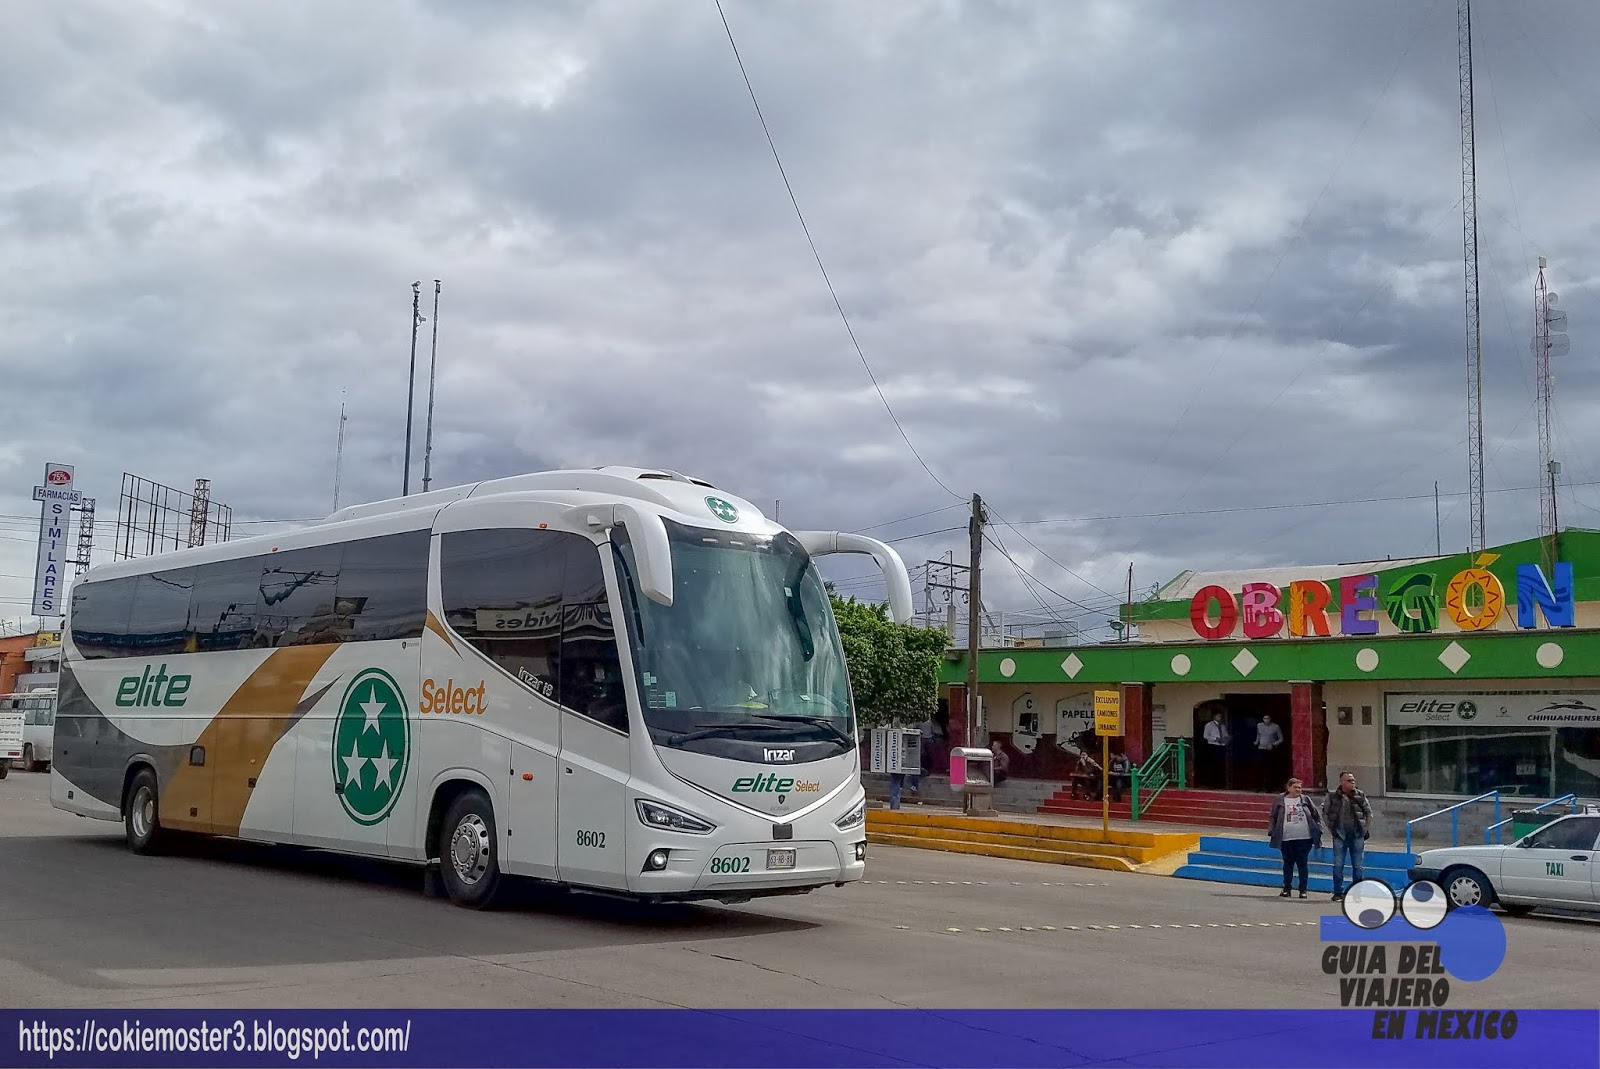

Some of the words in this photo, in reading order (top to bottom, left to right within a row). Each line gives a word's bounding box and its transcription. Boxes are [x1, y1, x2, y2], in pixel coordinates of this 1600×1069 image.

[52, 473, 67, 481] 75%
[38, 489, 79, 502] FARMACIAS
[42, 503, 63, 611] SIMILARES
[1190, 553, 1576, 639] OBREGÓN
[115, 664, 191, 707] elite
[518, 665, 543, 690] Irizar
[420, 678, 489, 715] Select
[1096, 696, 1119, 704] EXCLUSIVO
[1062, 710, 1095, 719] PAPELE
[1400, 699, 1456, 713] elite
[1425, 712, 1451, 721] Select
[763, 748, 796, 761] Irizar
[731, 773, 794, 792] elite
[795, 780, 820, 792] Select
[576, 830, 606, 849] 8602
[710, 856, 750, 874] 8602
[1545, 861, 1564, 877] TAXI
